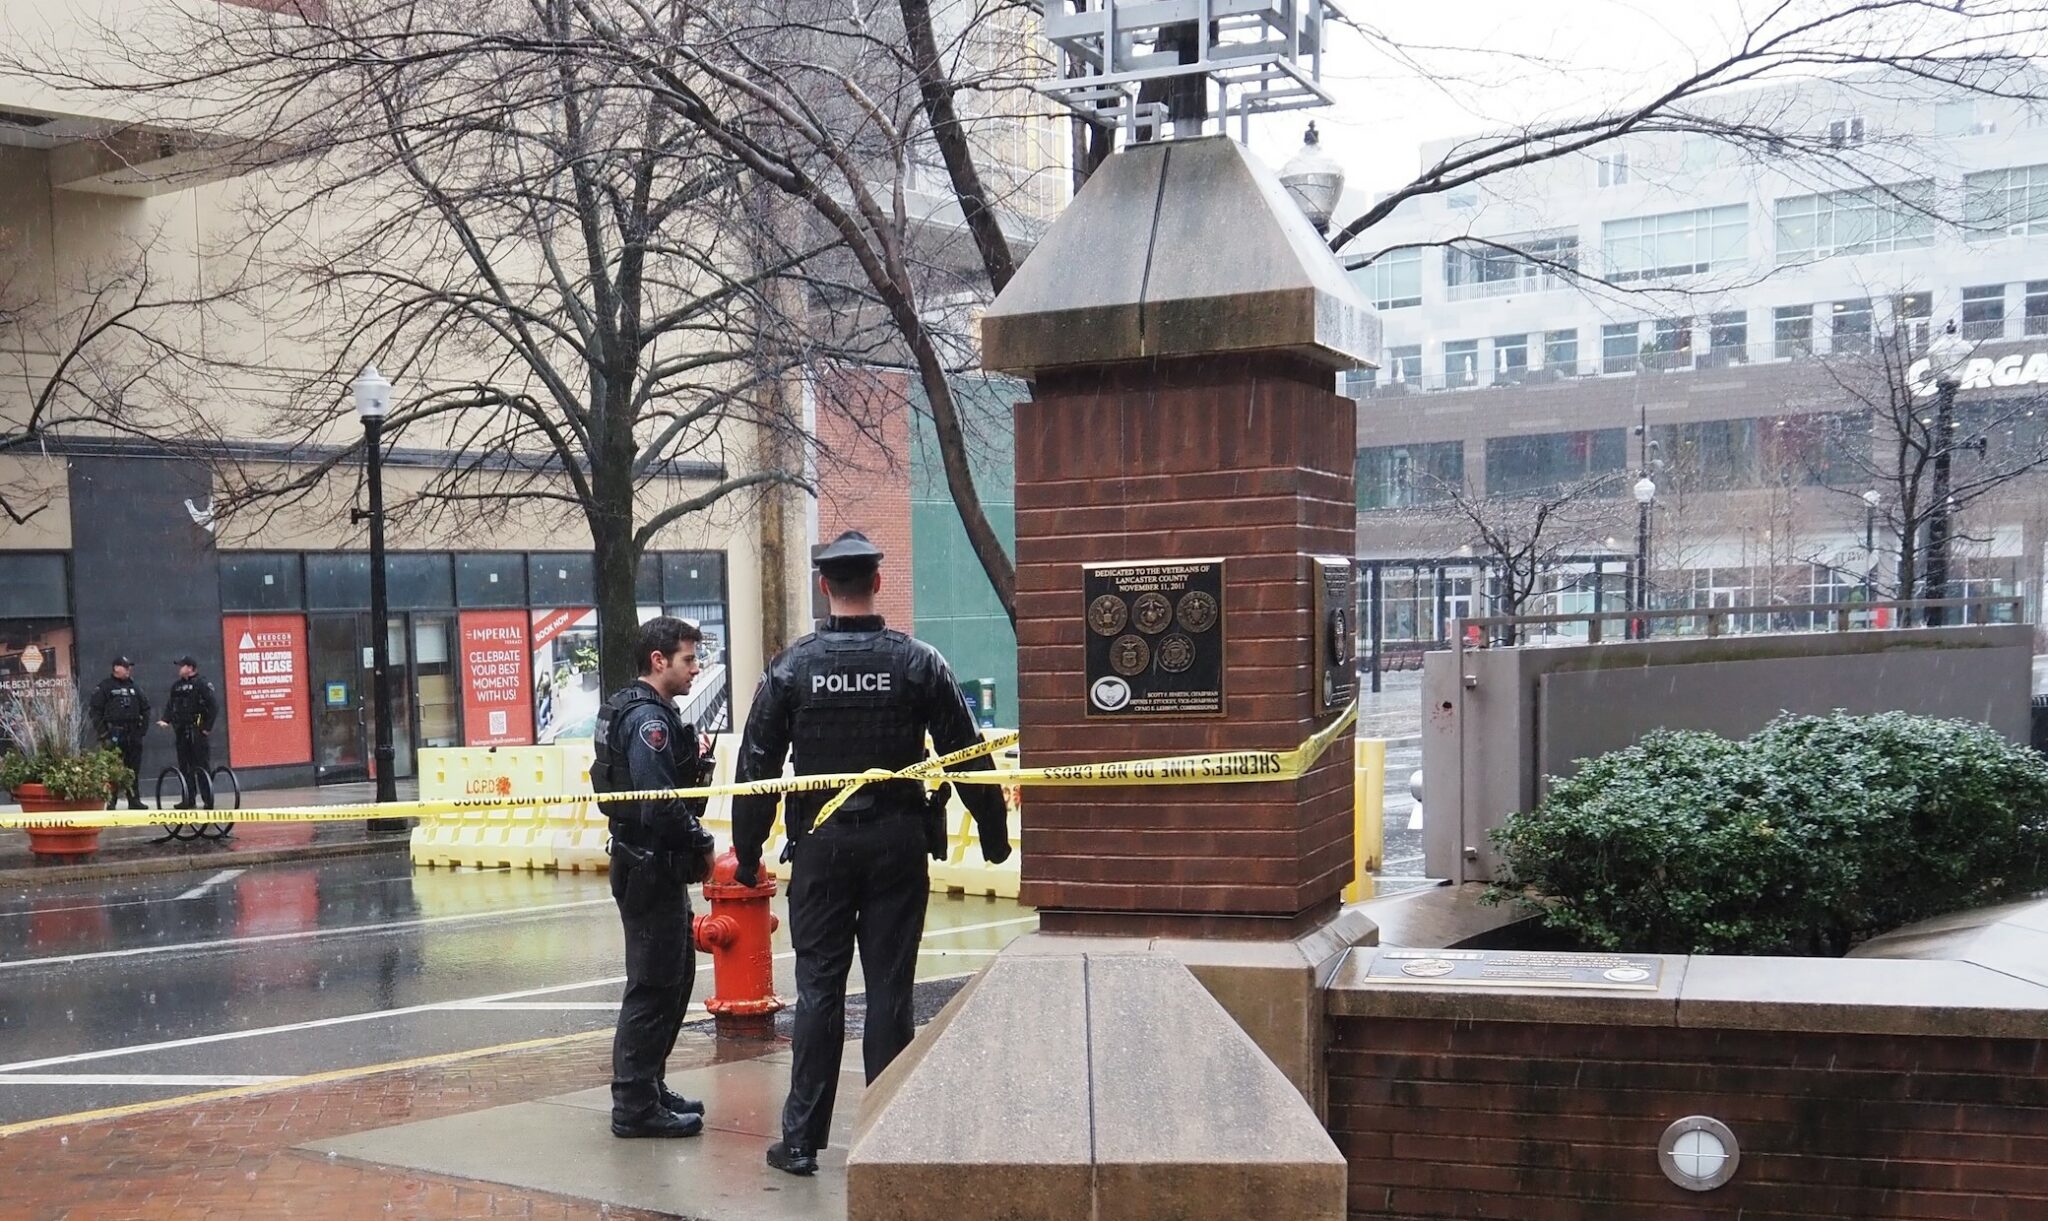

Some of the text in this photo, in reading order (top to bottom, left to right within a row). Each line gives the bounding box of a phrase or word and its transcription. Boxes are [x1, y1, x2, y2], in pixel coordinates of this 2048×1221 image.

[1905, 353, 2048, 397] CRGA
[1095, 568, 1134, 577] DEDICATED
[1146, 567, 1160, 575] THE
[1161, 565, 1199, 574] VETERANS
[1115, 574, 1189, 585] LANCASTER COUNTY
[1119, 584, 1159, 592] NOVEMBER
[535, 611, 569, 642] BOOK NOW
[473, 626, 522, 641] IMPERIAL
[239, 651, 292, 662] PRIME LOCATION
[469, 650, 520, 663] CELEBRATE
[240, 660, 293, 674] FOR LEASE
[471, 663, 520, 676] YOUR BEST
[11, 679, 30, 689] BEST
[257, 674, 293, 685] OCCUPANCY
[472, 676, 520, 689] MOMENTS
[812, 673, 891, 693] POLICE
[476, 689, 517, 701] WITH US!
[1043, 754, 1281, 779] SHERIFF'S LINE DO NOT CROSS
